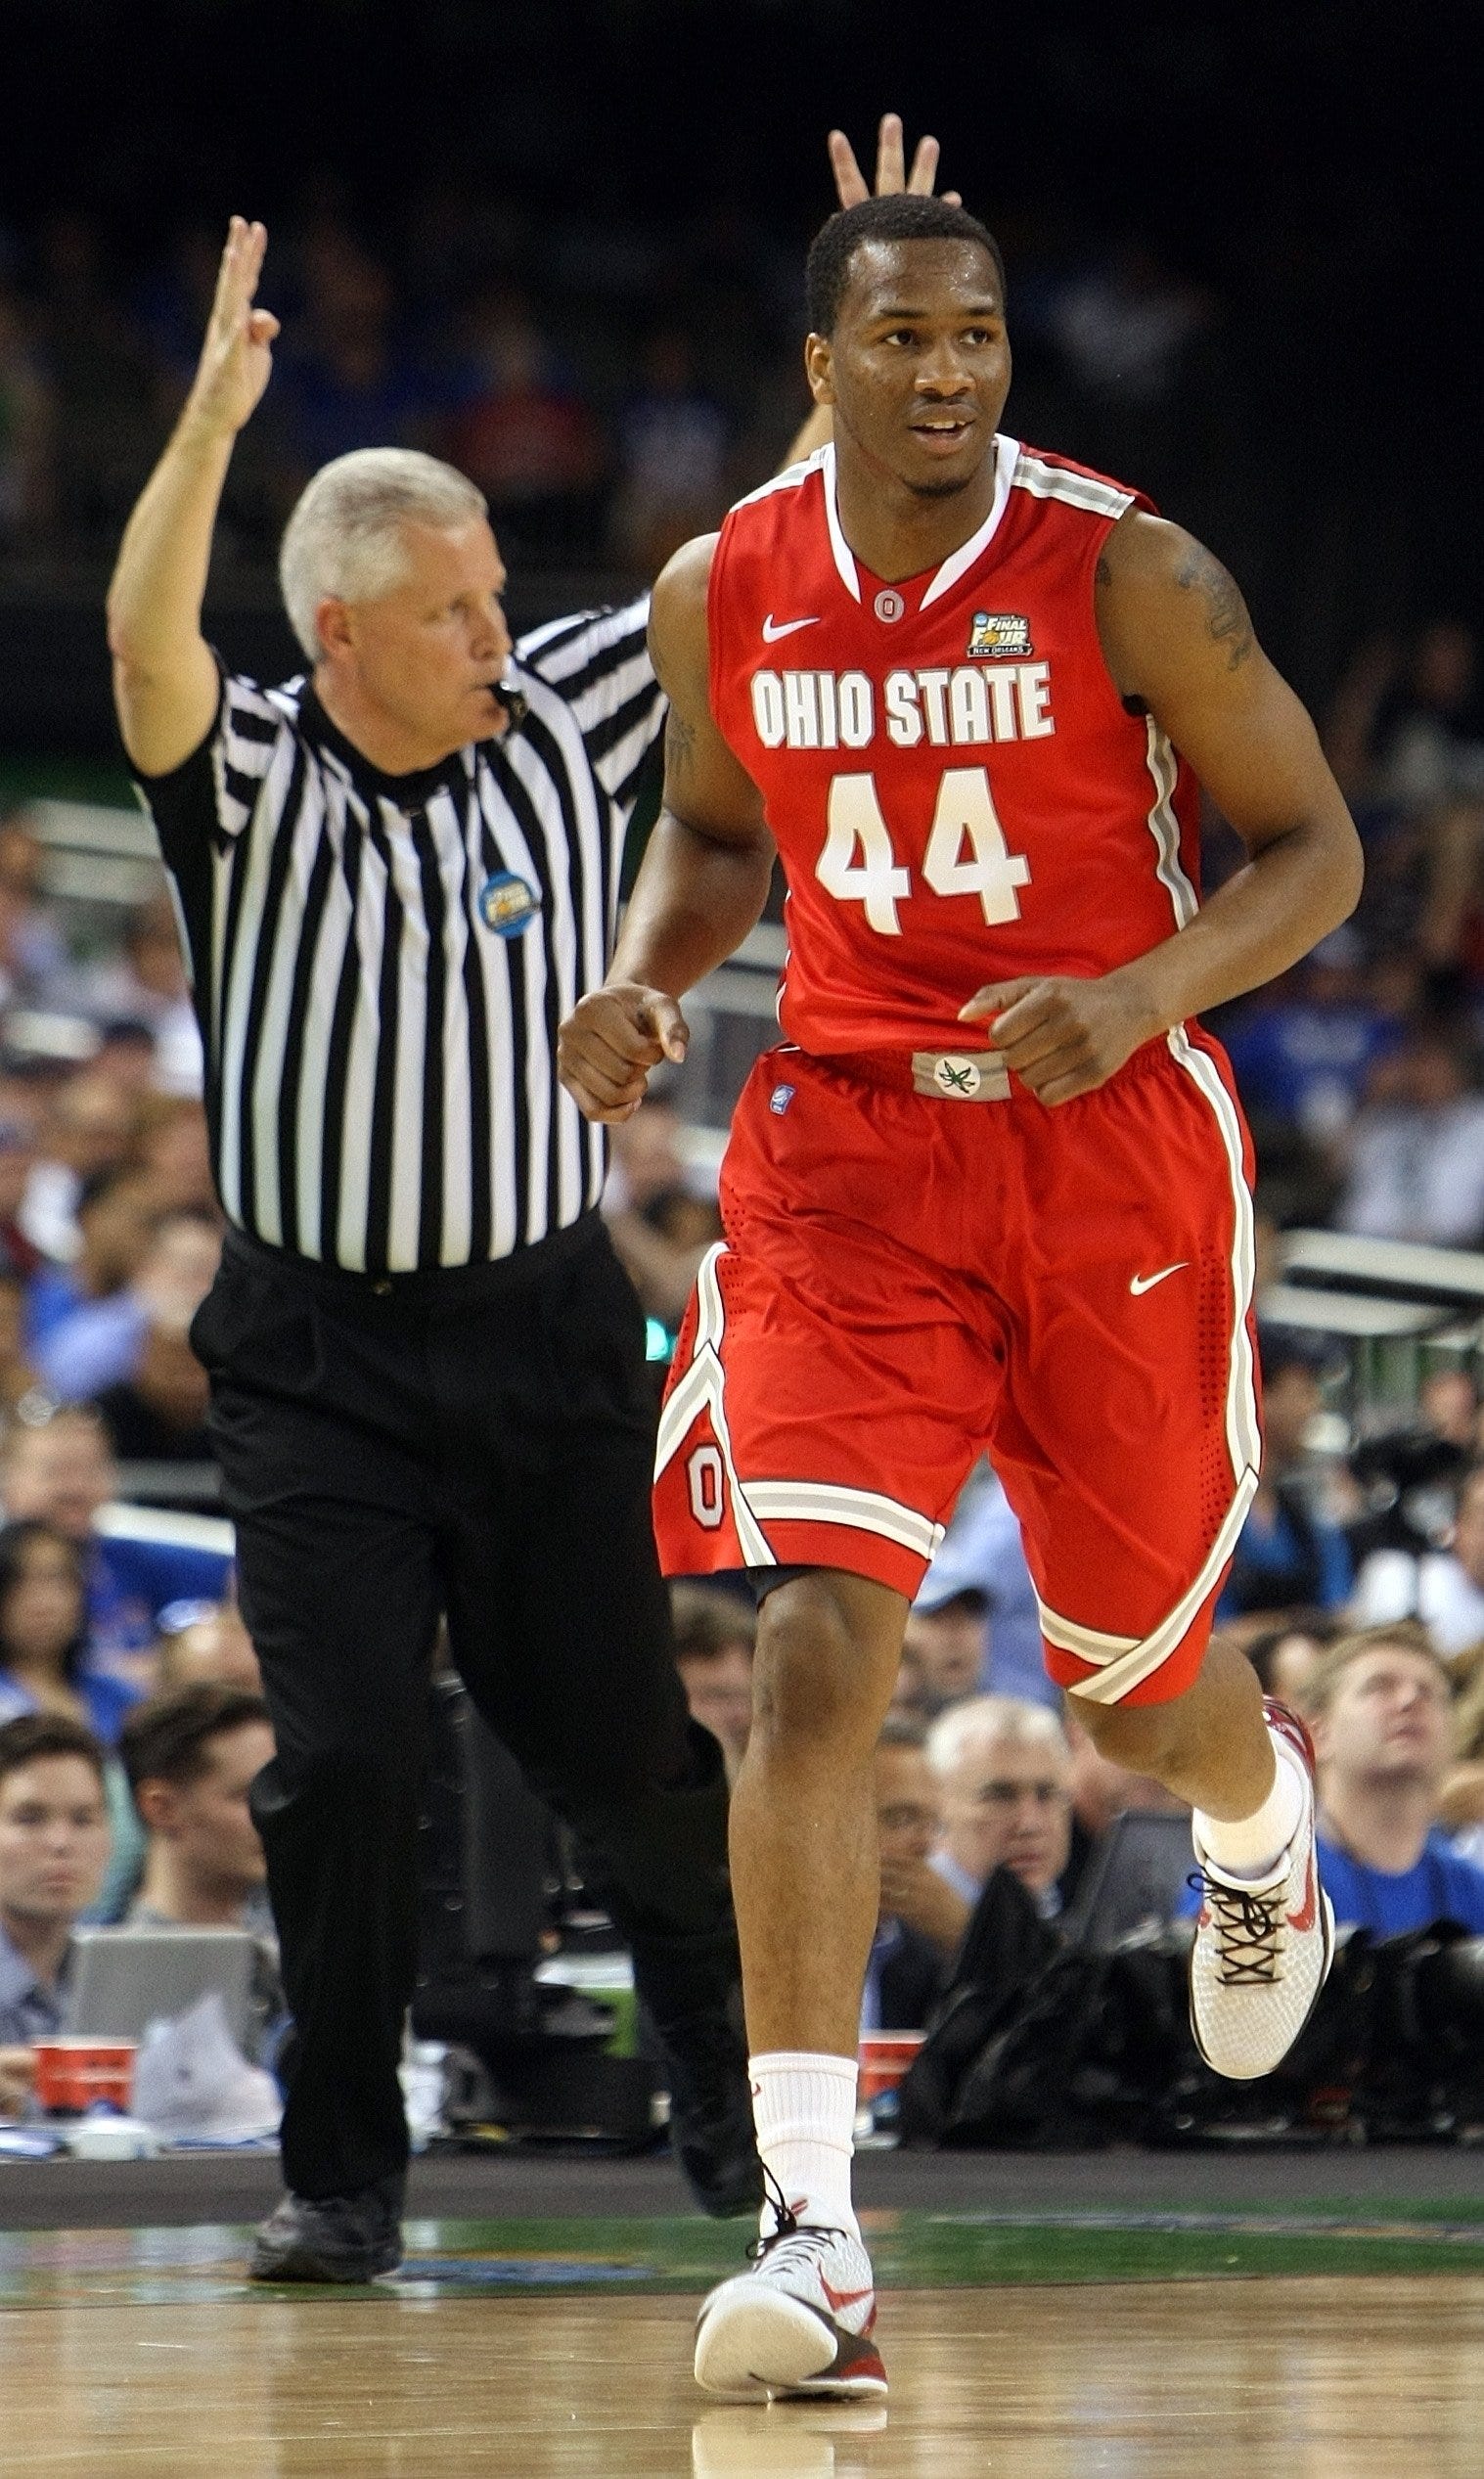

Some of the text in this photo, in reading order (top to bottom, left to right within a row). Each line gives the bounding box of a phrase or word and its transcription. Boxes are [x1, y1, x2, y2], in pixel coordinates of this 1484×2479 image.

[987, 617, 1027, 631] FINAL
[750, 661, 1056, 749] OHIO STATE
[815, 766, 1031, 936] 44
